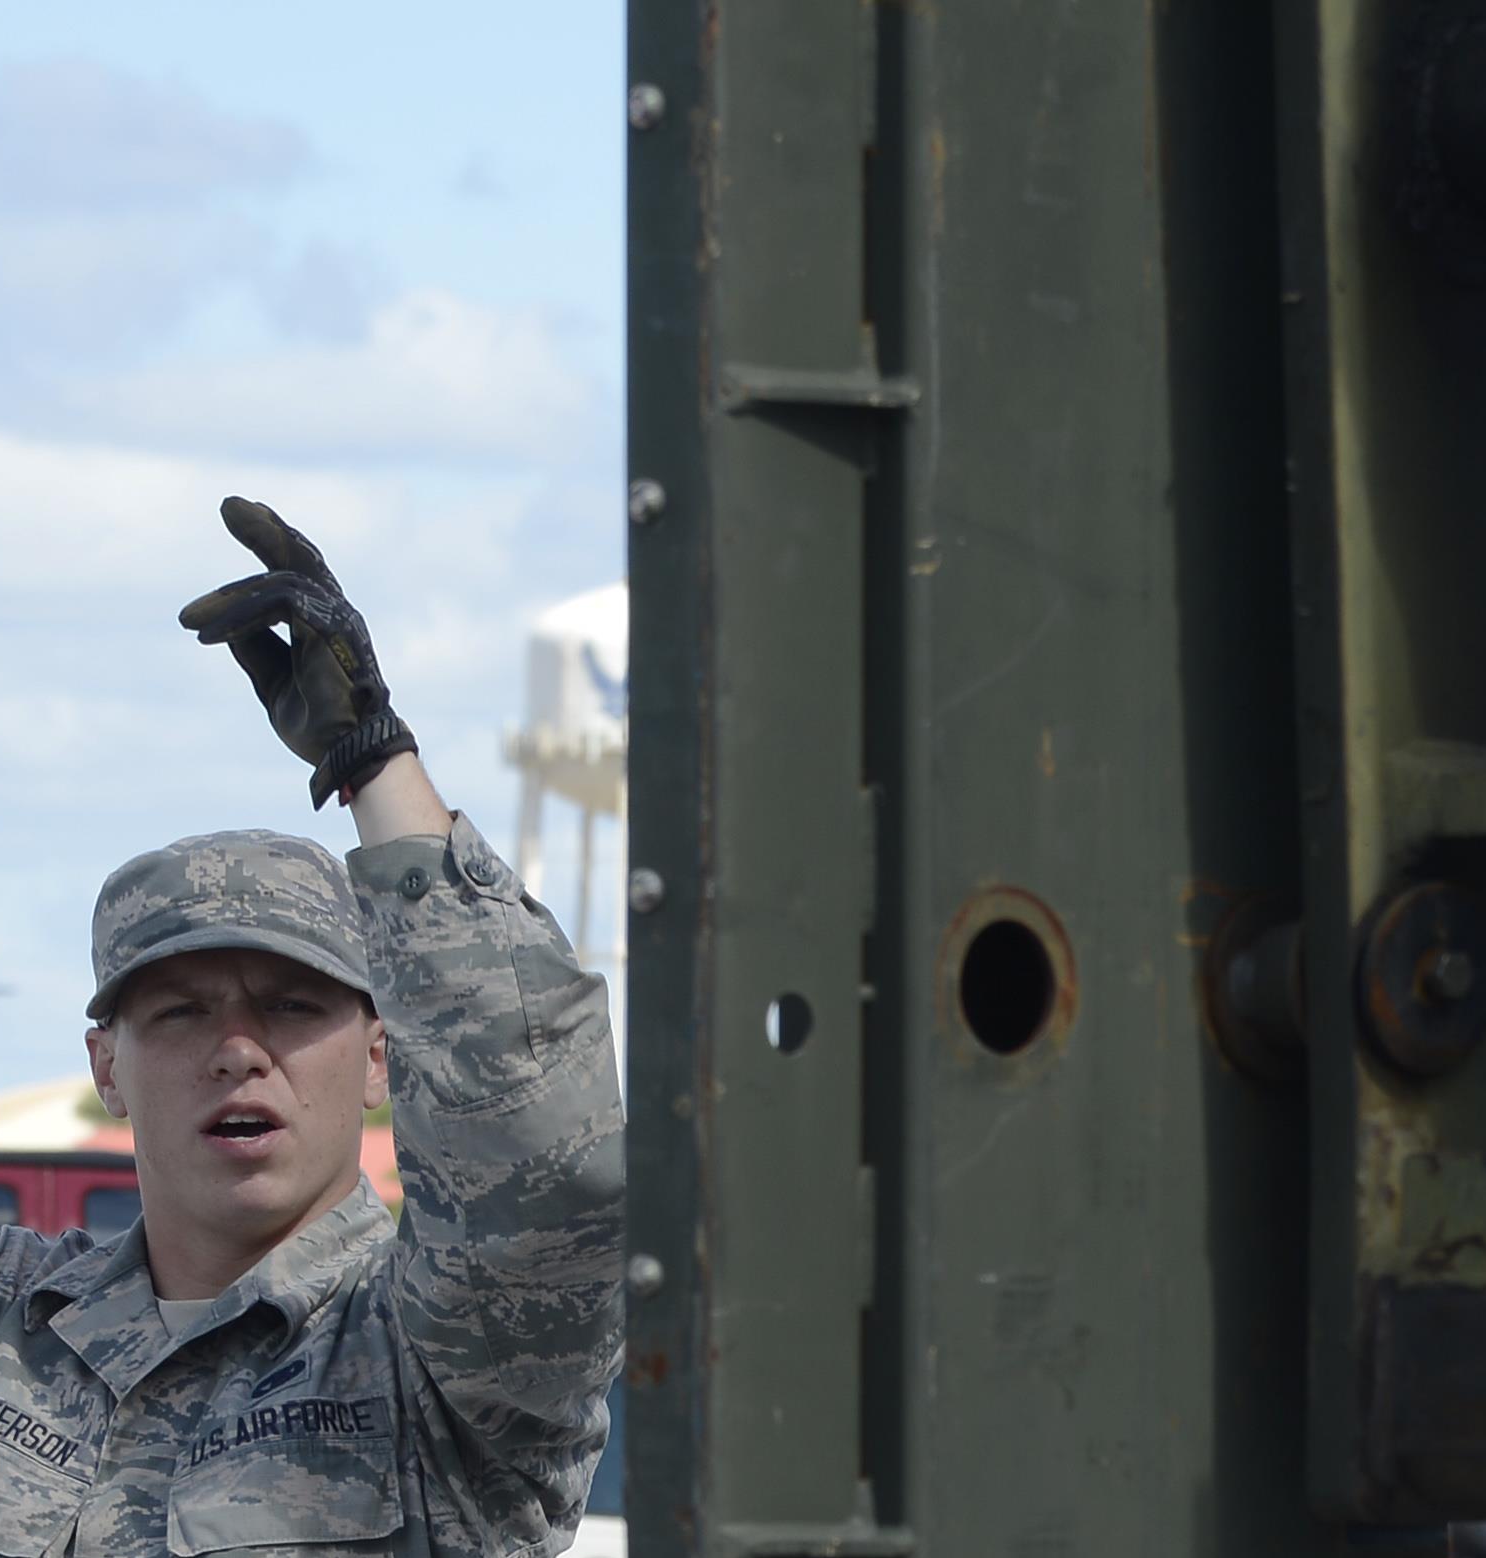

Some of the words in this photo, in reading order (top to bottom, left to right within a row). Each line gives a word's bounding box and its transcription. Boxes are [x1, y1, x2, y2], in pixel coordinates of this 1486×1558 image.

[189, 1427, 229, 1467] U.S.
[235, 1407, 281, 1446] AIR
[282, 1399, 375, 1434] FORCE
